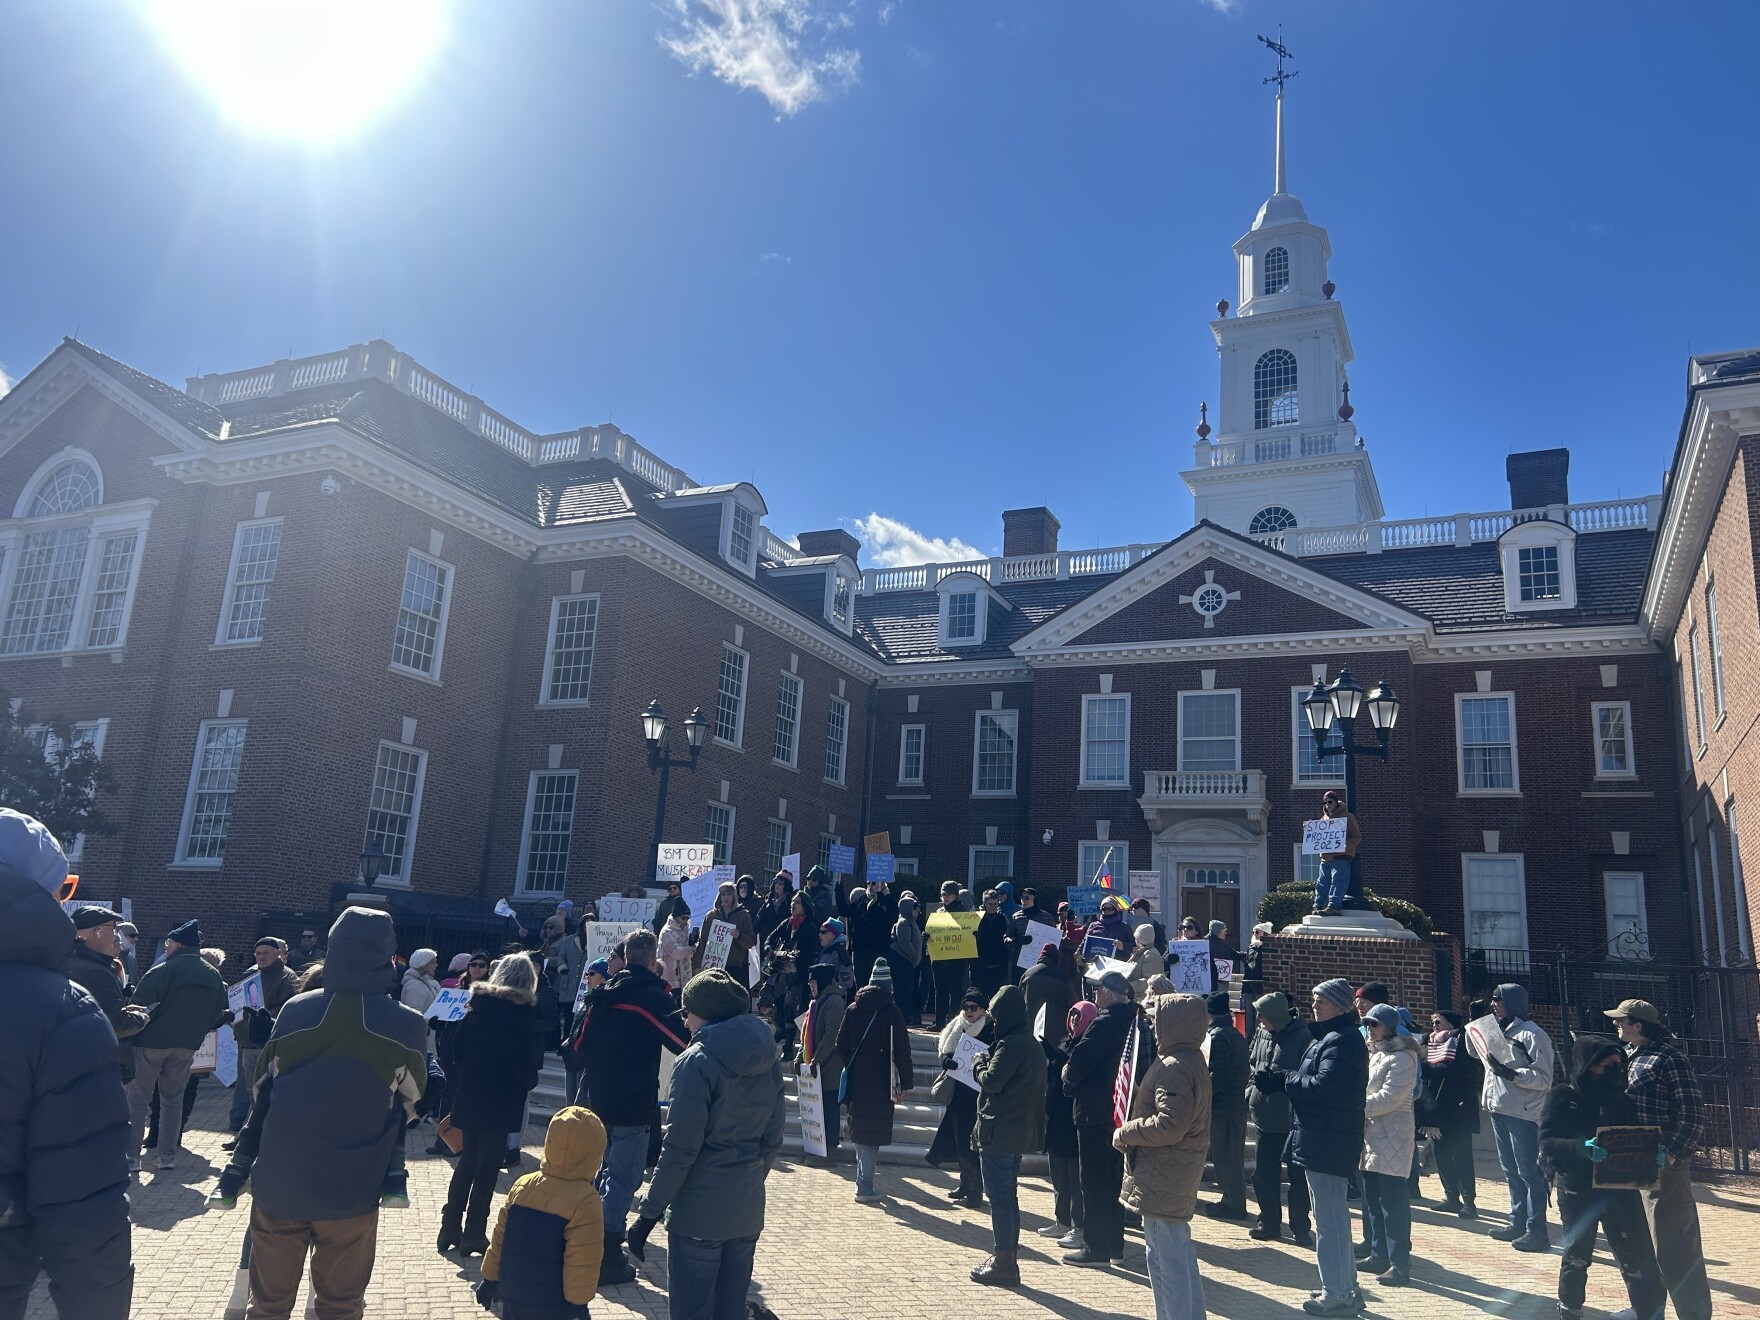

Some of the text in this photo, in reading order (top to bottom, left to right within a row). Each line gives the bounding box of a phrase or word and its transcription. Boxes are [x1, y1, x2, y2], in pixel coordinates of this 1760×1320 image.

[1307, 820, 1335, 832] STOP
[1305, 831, 1346, 843] PROJECT
[1313, 840, 1342, 851] 2025
[603, 900, 654, 916] STOP
[713, 924, 731, 937] KEEP
[951, 934, 963, 942] OUT
[437, 990, 468, 1008] People
